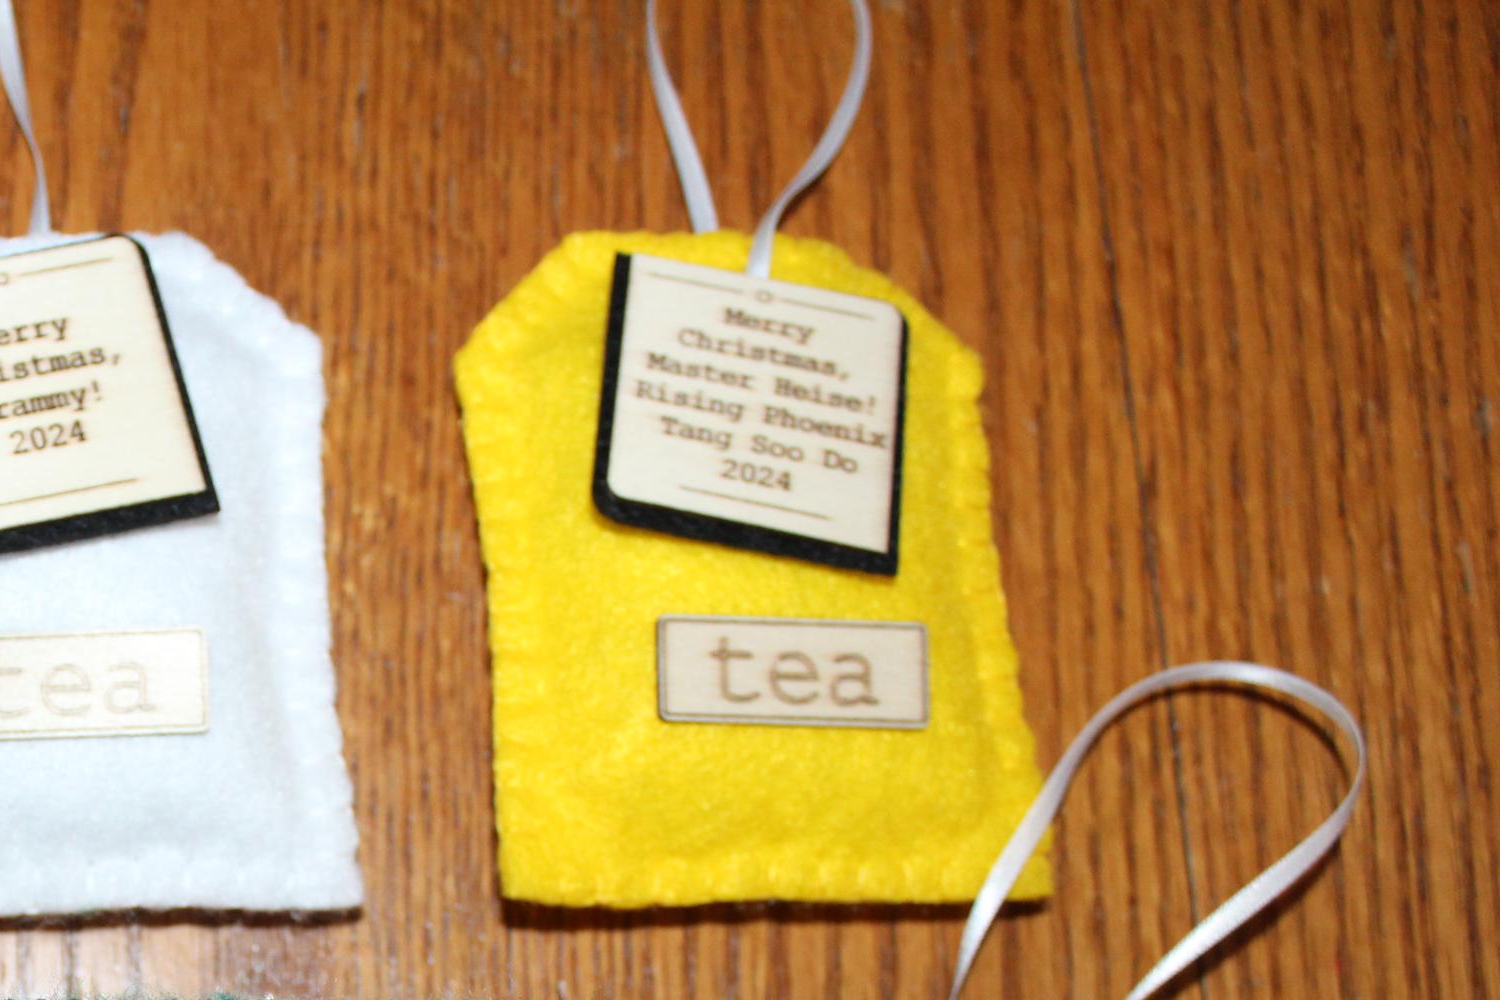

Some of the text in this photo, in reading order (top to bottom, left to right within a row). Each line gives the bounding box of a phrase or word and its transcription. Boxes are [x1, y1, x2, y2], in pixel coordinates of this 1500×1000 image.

[723, 307, 816, 345] Merry
[645, 352, 756, 390] Master
[677, 328, 849, 381] Christmas,
[10, 420, 87, 454] 2024
[635, 380, 889, 450] Rising Phoenix
[659, 416, 858, 474] Tang Soo Do
[720, 459, 792, 491] 2024
[709, 636, 880, 707] tea
